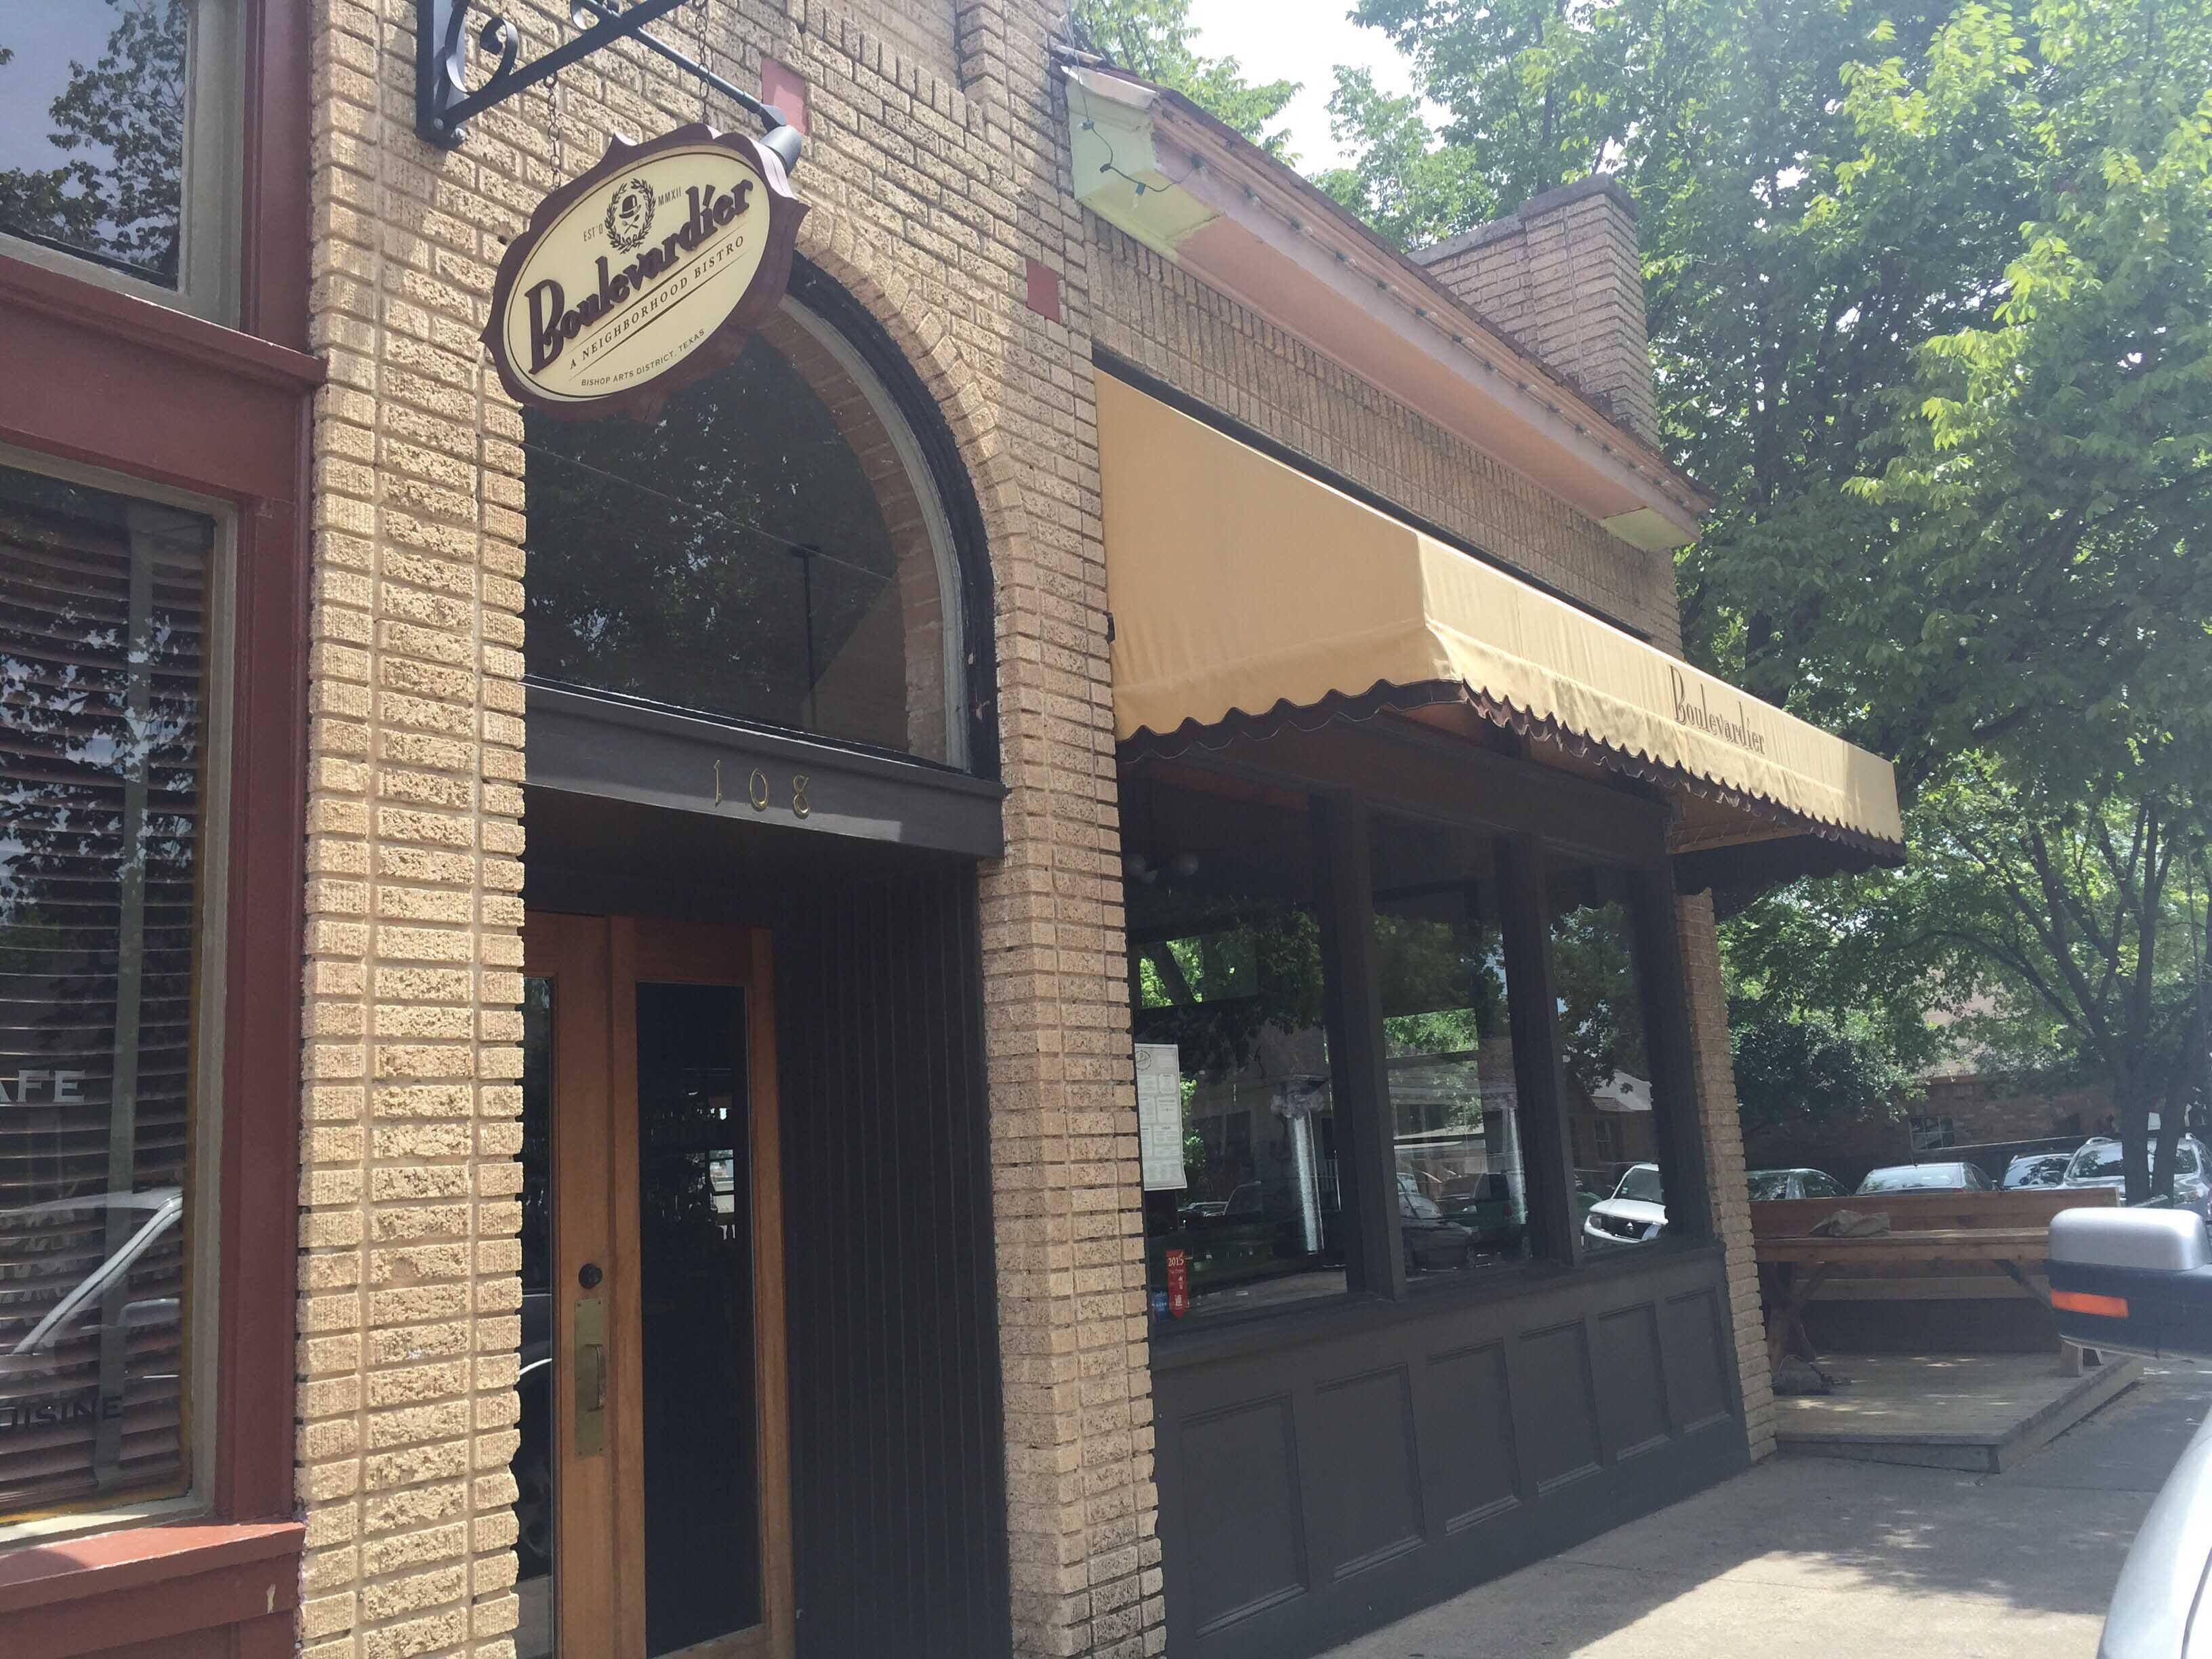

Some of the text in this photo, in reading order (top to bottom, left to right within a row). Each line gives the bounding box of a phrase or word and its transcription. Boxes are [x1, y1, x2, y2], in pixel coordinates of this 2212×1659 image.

[583, 186, 682, 242] EST'D MMXII
[524, 178, 754, 375] Boulevardier
[569, 235, 744, 369] A NEIGHBORHOOD BISTRO
[581, 329, 705, 386] BISHOP ARTS DISTRICT, TEXAS
[1670, 665, 1765, 755] Boulevardier
[714, 759, 810, 819] 108
